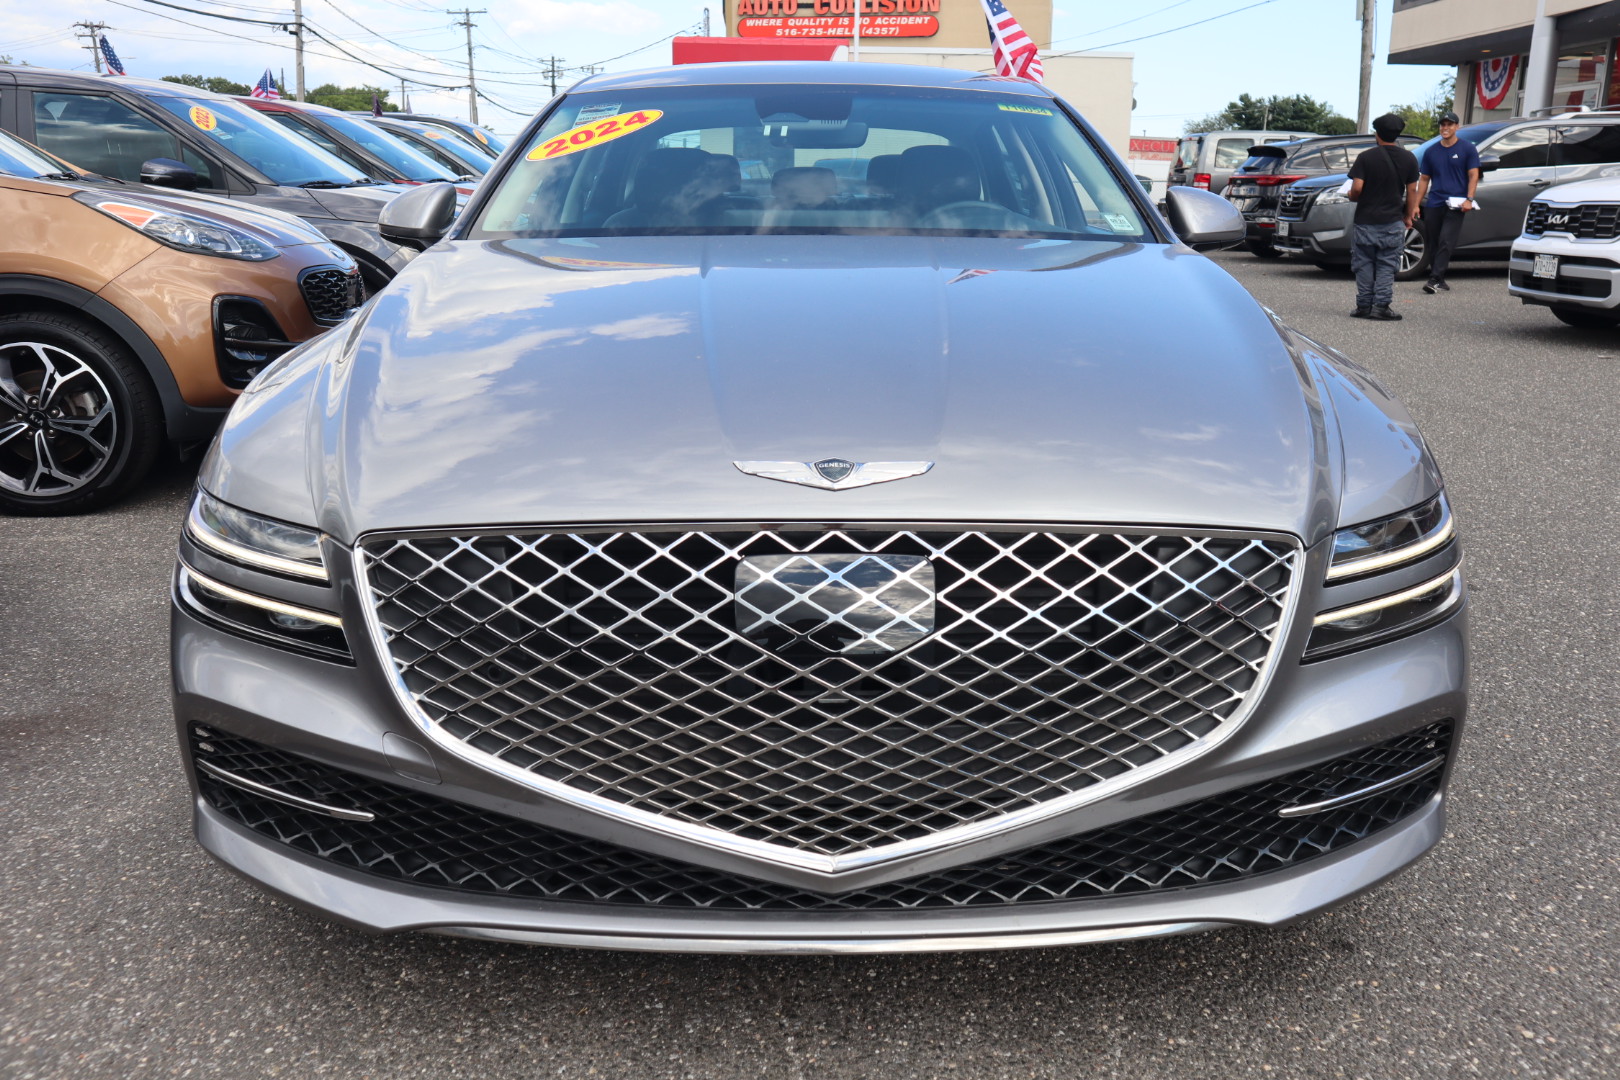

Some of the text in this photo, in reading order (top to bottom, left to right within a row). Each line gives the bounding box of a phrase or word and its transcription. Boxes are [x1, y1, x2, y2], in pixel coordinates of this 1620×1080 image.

[737, 0, 940, 15] AUTO COLLISION
[745, 19, 783, 27] WHERE
[787, 18, 833, 26] QUALITY
[838, 17, 849, 25] IS
[874, 16, 931, 25] ACCIDENT
[775, 26, 900, 36] 516-735-HEL (4357)
[543, 111, 651, 157] 2024
[1548, 214, 1570, 225] KIA
